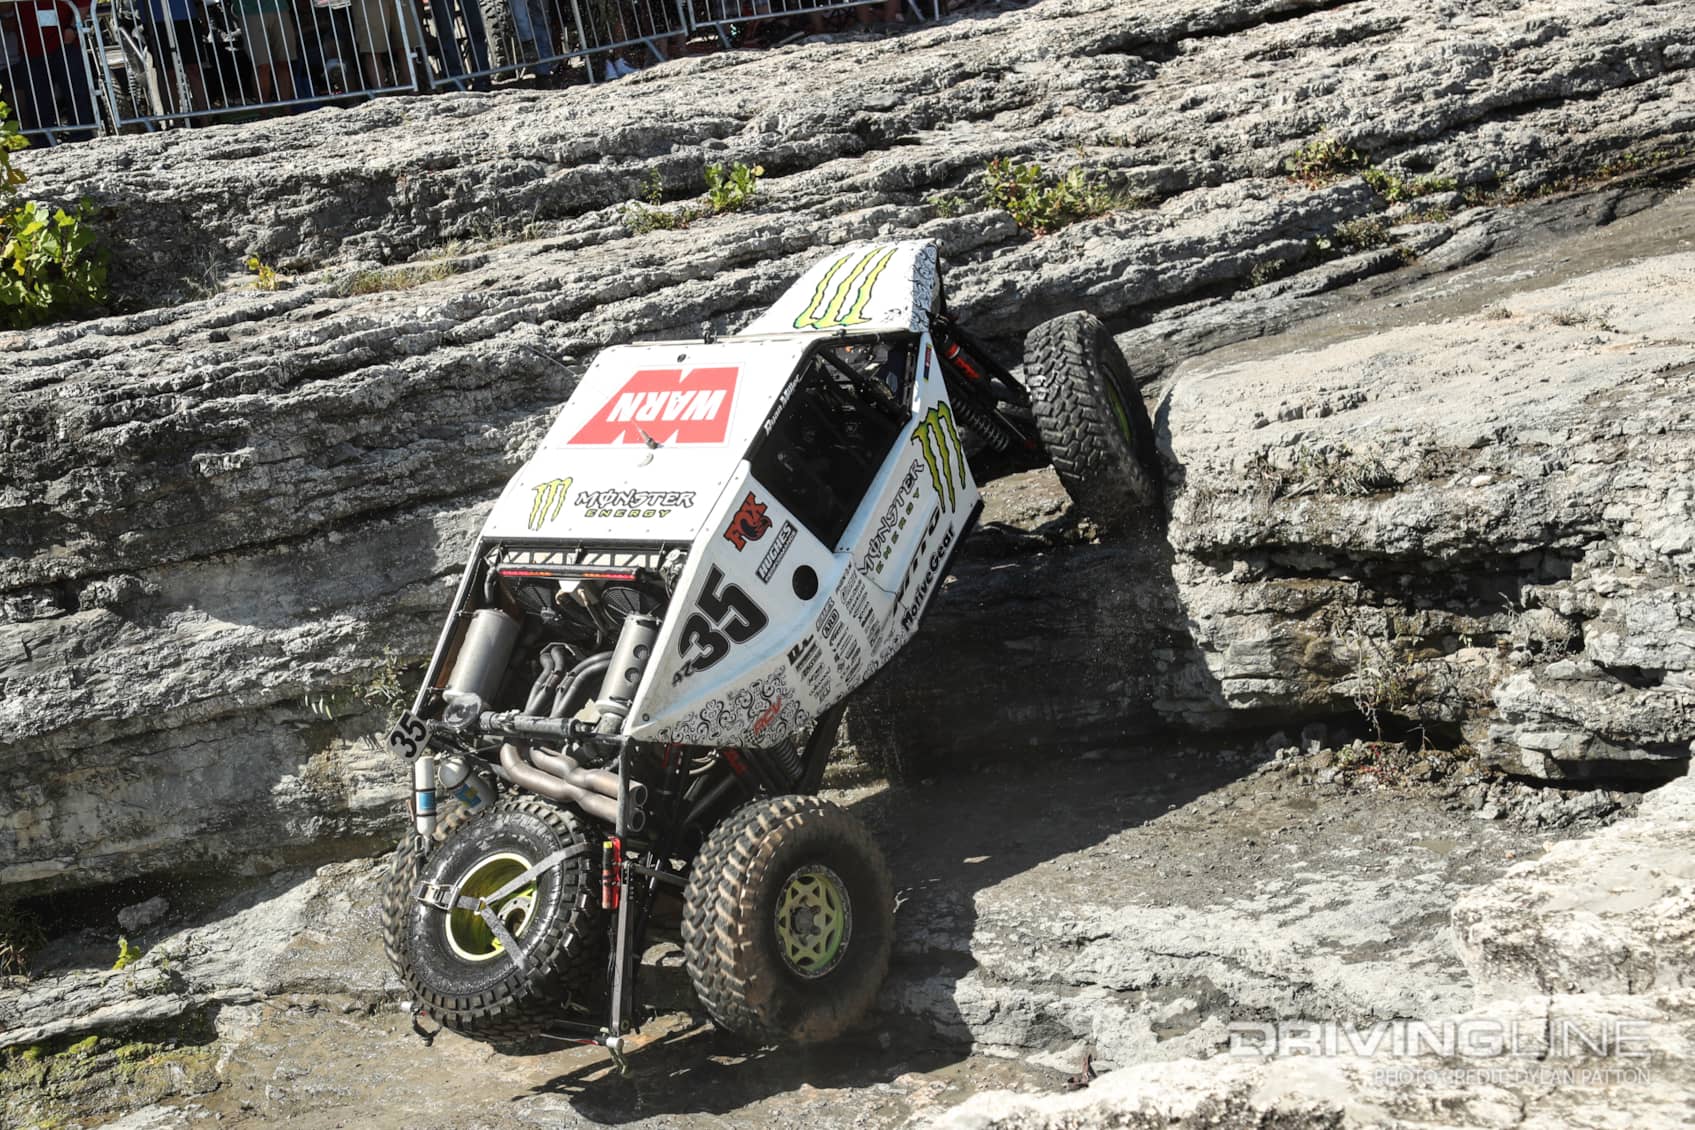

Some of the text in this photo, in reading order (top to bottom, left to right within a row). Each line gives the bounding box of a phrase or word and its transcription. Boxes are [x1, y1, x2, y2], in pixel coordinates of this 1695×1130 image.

[606, 389, 727, 423] WARN
[584, 509, 671, 518] ENERGY
[723, 491, 773, 552] FOX
[876, 487, 921, 575] ENERGY
[757, 521, 792, 579] HUGHES
[678, 562, 769, 672] 35
[390, 712, 427, 758] 35
